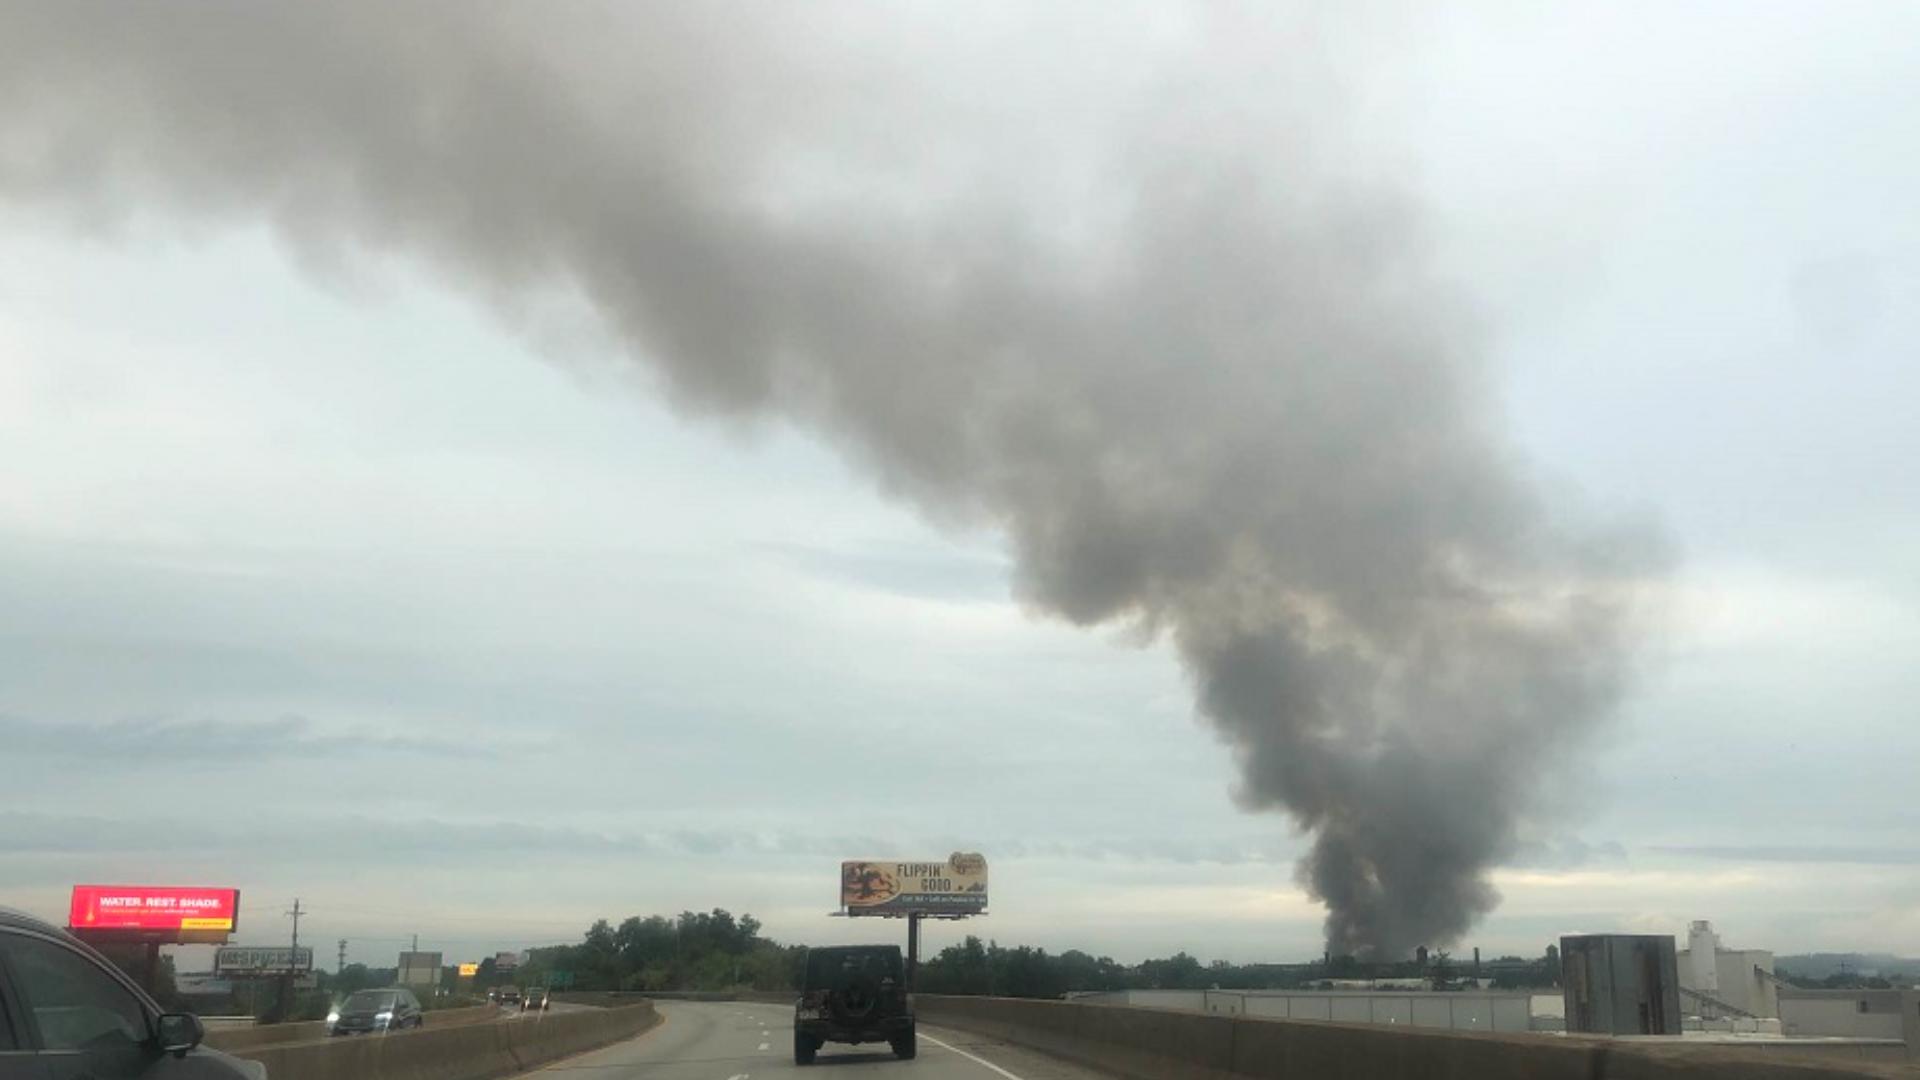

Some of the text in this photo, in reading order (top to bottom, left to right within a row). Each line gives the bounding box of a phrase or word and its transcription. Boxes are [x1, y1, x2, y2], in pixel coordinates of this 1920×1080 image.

[920, 878, 951, 892] GOOD
[100, 897, 222, 908] WATER. REST. SHADE.
